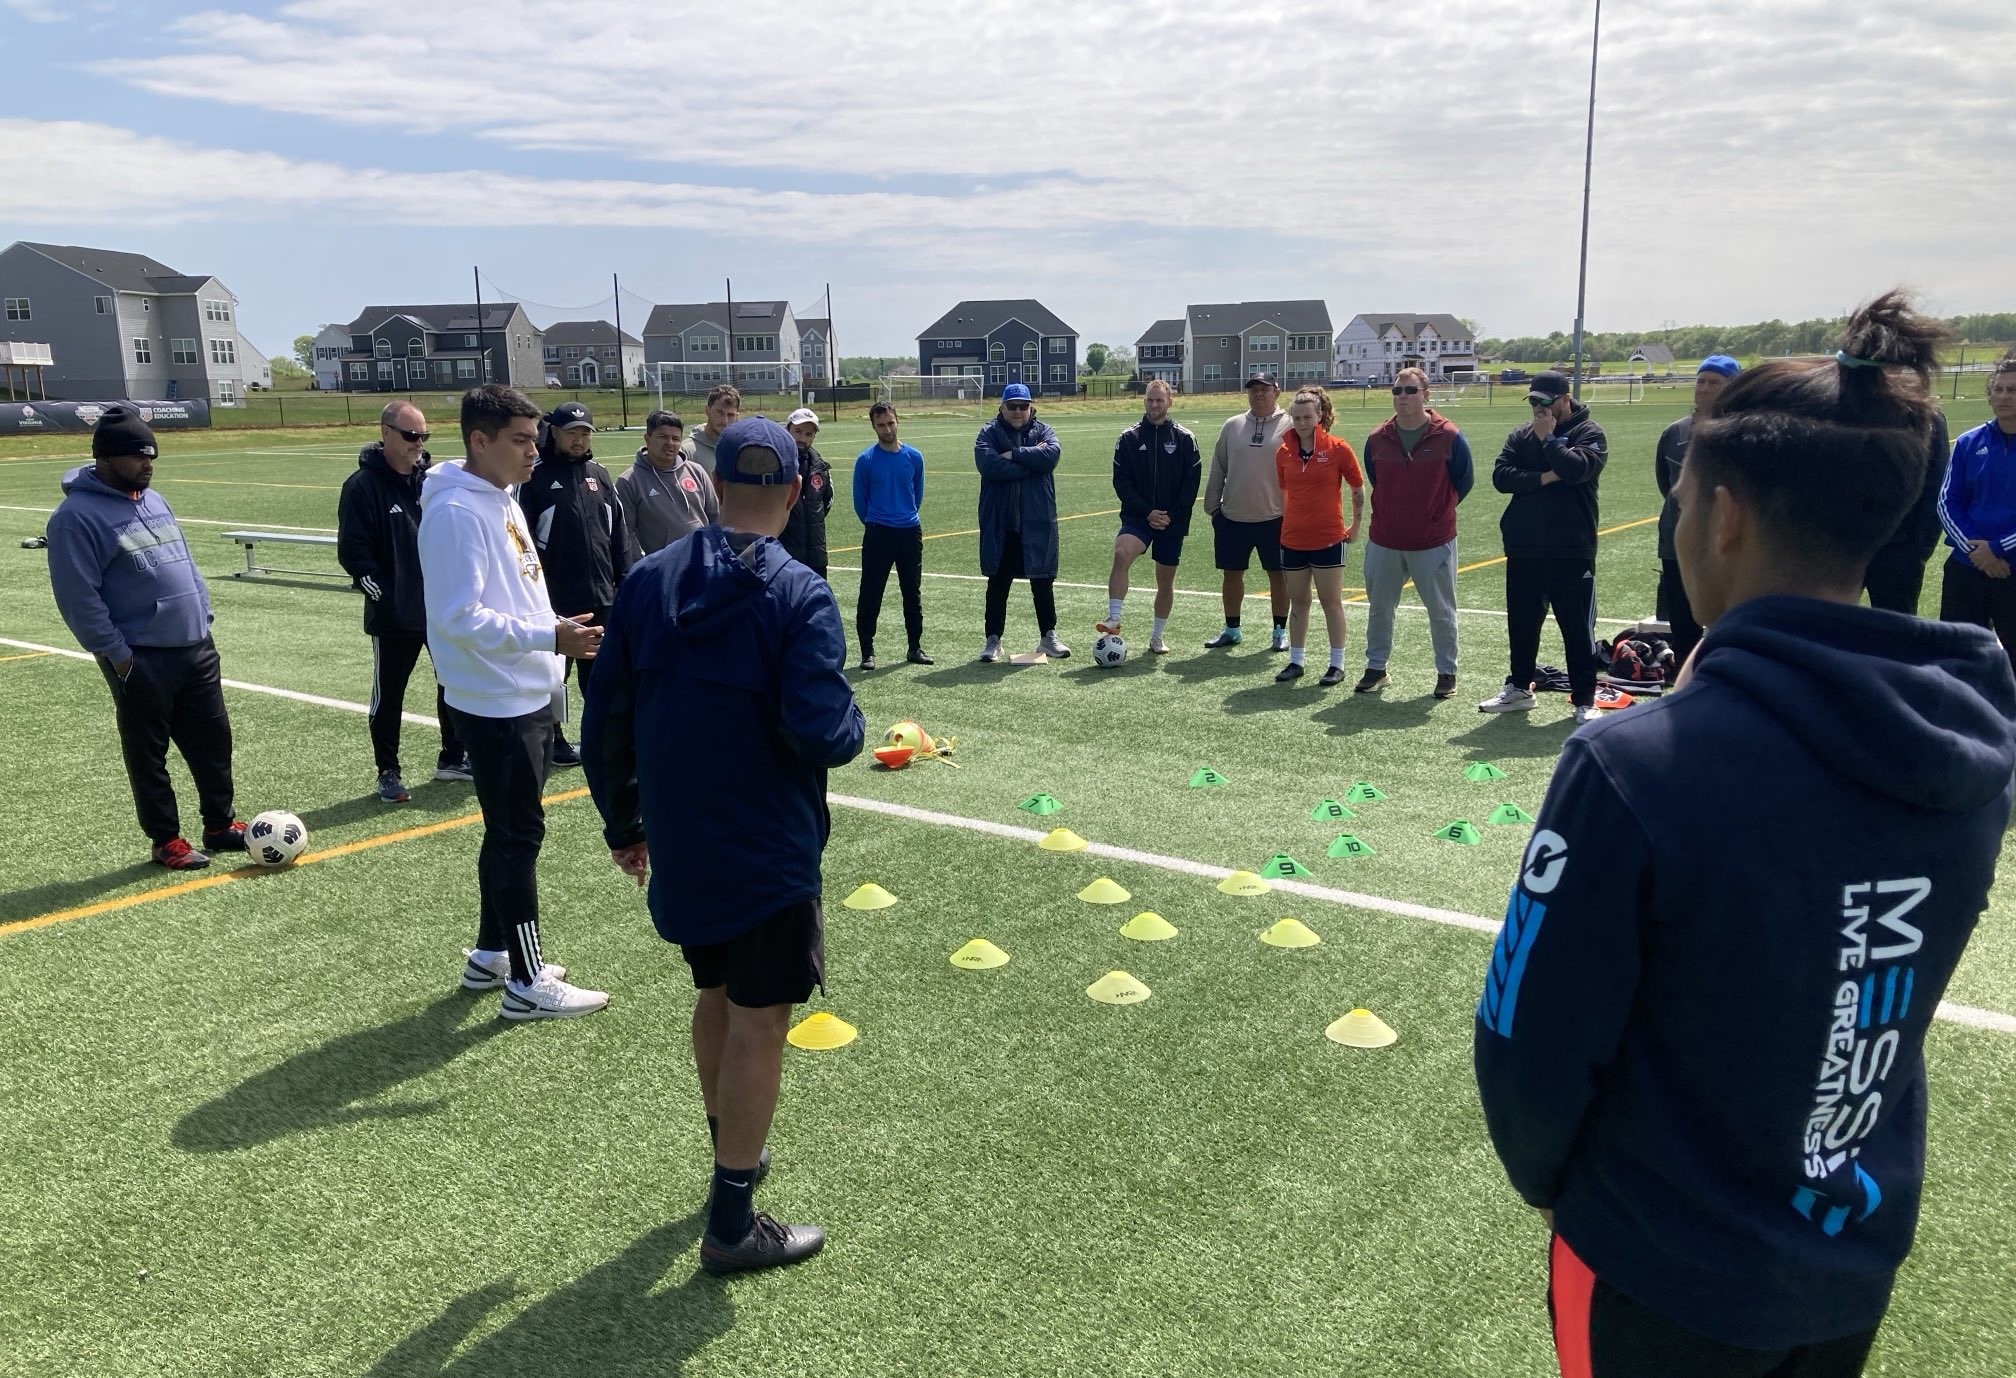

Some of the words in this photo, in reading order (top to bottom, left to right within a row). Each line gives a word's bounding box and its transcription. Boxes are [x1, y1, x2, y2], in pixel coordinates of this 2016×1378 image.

[133, 550, 159, 572] DC
[1204, 772, 1217, 783] 2
[1362, 788, 1376, 799] 5
[1328, 805, 1343, 817] 8
[1505, 809, 1520, 821] 4
[1448, 826, 1464, 839] 6
[1345, 841, 1361, 853] 10
[1279, 862, 1296, 875] 9
[1838, 882, 1871, 972] LIVE
[1803, 980, 1860, 1179] GREATNESS
